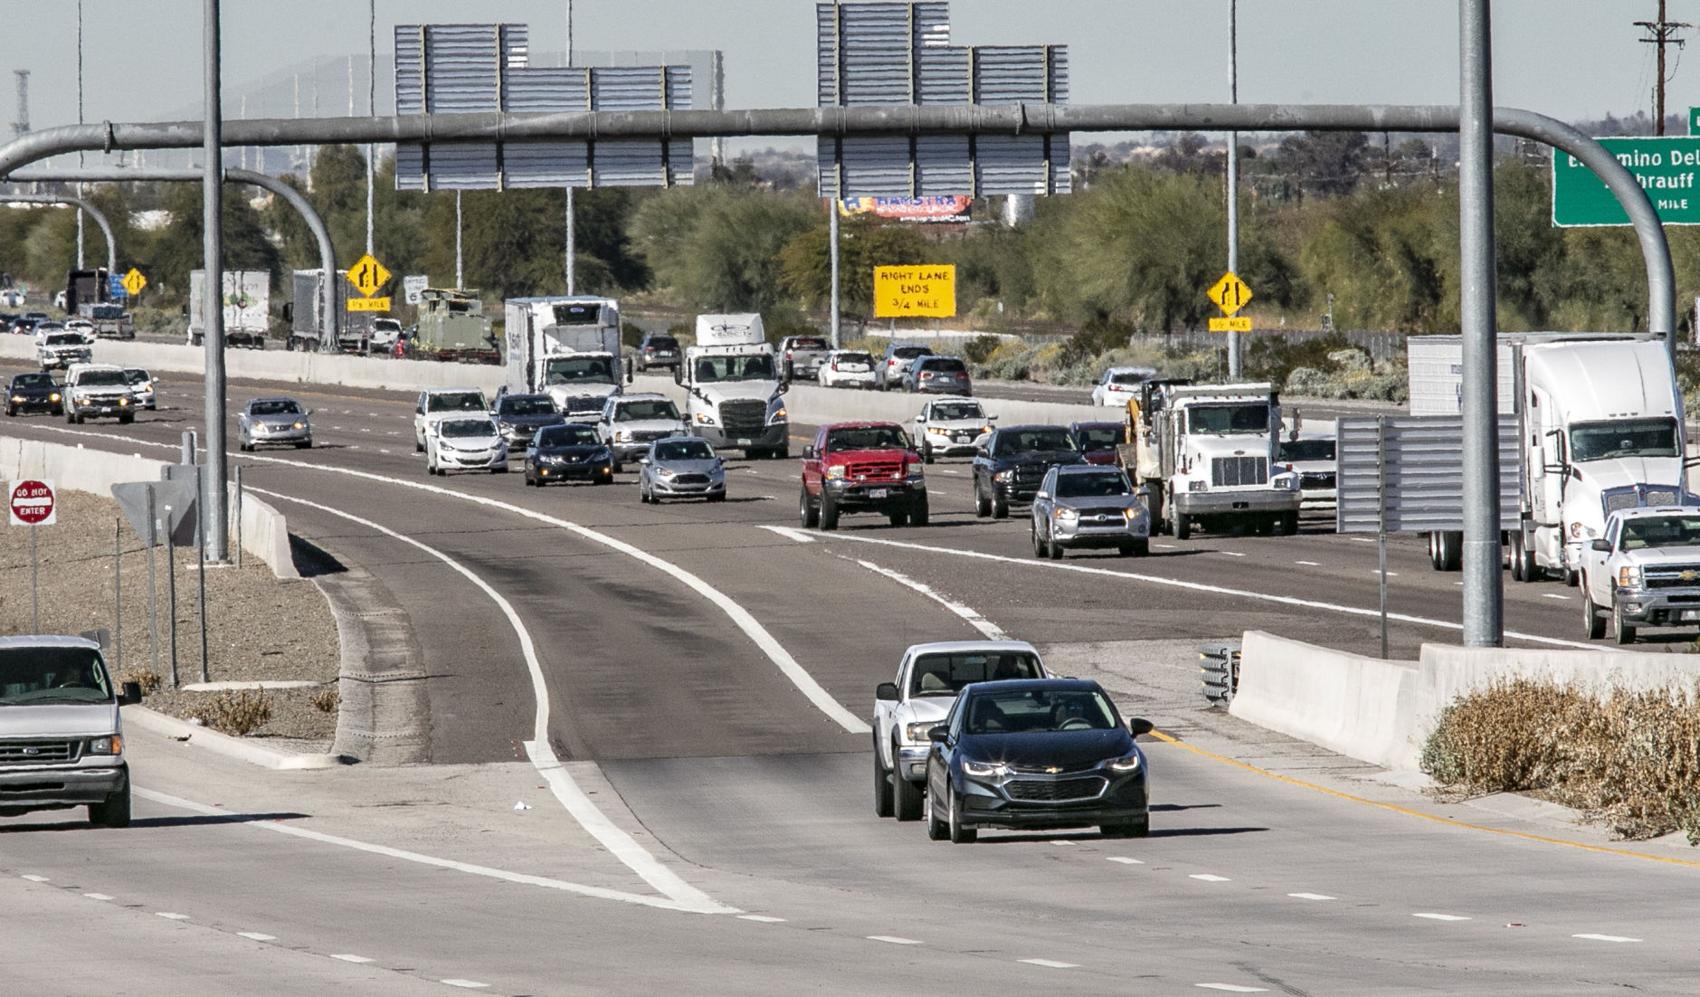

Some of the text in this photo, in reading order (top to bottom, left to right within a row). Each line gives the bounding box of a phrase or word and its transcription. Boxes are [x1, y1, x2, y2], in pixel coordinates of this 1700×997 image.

[1616, 149, 1662, 167] mino
[1670, 149, 1700, 166] Del
[1657, 199, 1689, 210] MILE
[881, 271, 949, 280] RIGHT LANE
[900, 284, 929, 294] ENDS
[917, 299, 939, 309] MILE
[16, 487, 48, 497] DO NOT
[20, 507, 46, 515] ENTER
